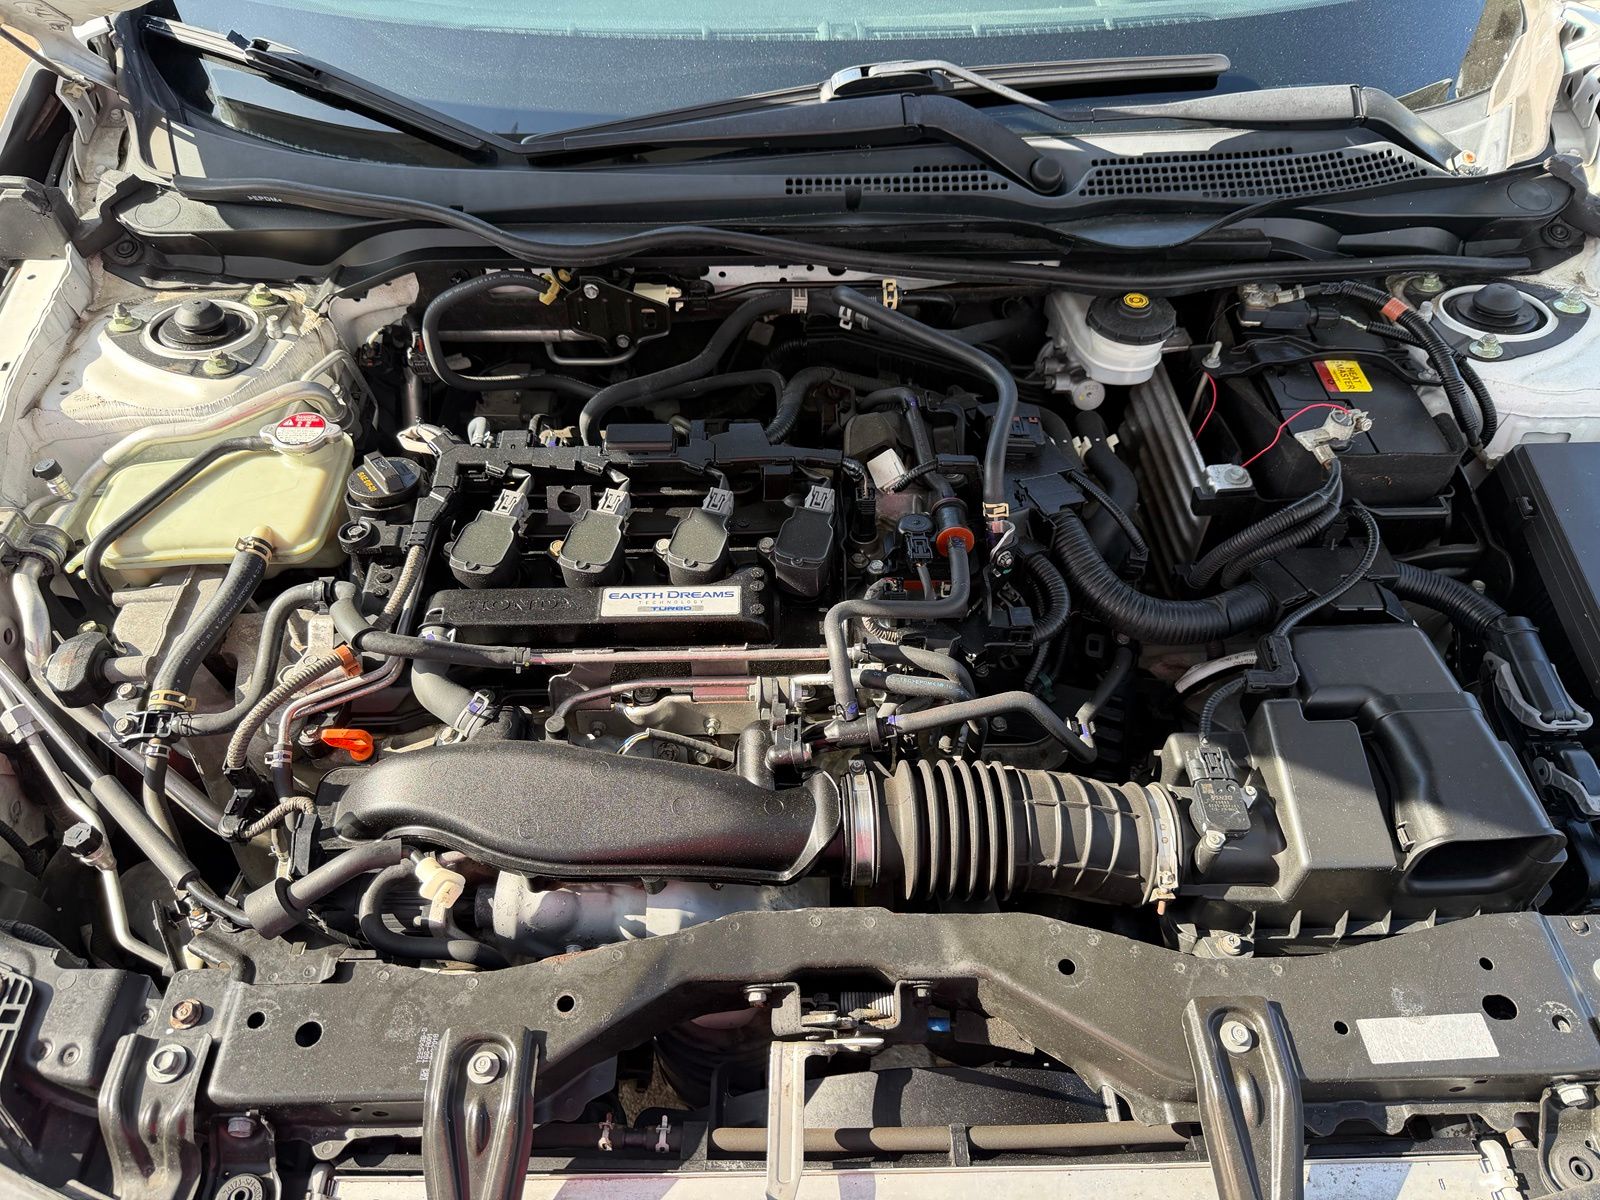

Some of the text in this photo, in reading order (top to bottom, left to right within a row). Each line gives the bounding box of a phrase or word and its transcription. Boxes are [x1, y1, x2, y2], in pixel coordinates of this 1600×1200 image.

[1335, 364, 1355, 390] MASTER
[1345, 367, 1362, 384] HEAT
[608, 592, 663, 600] EARTH
